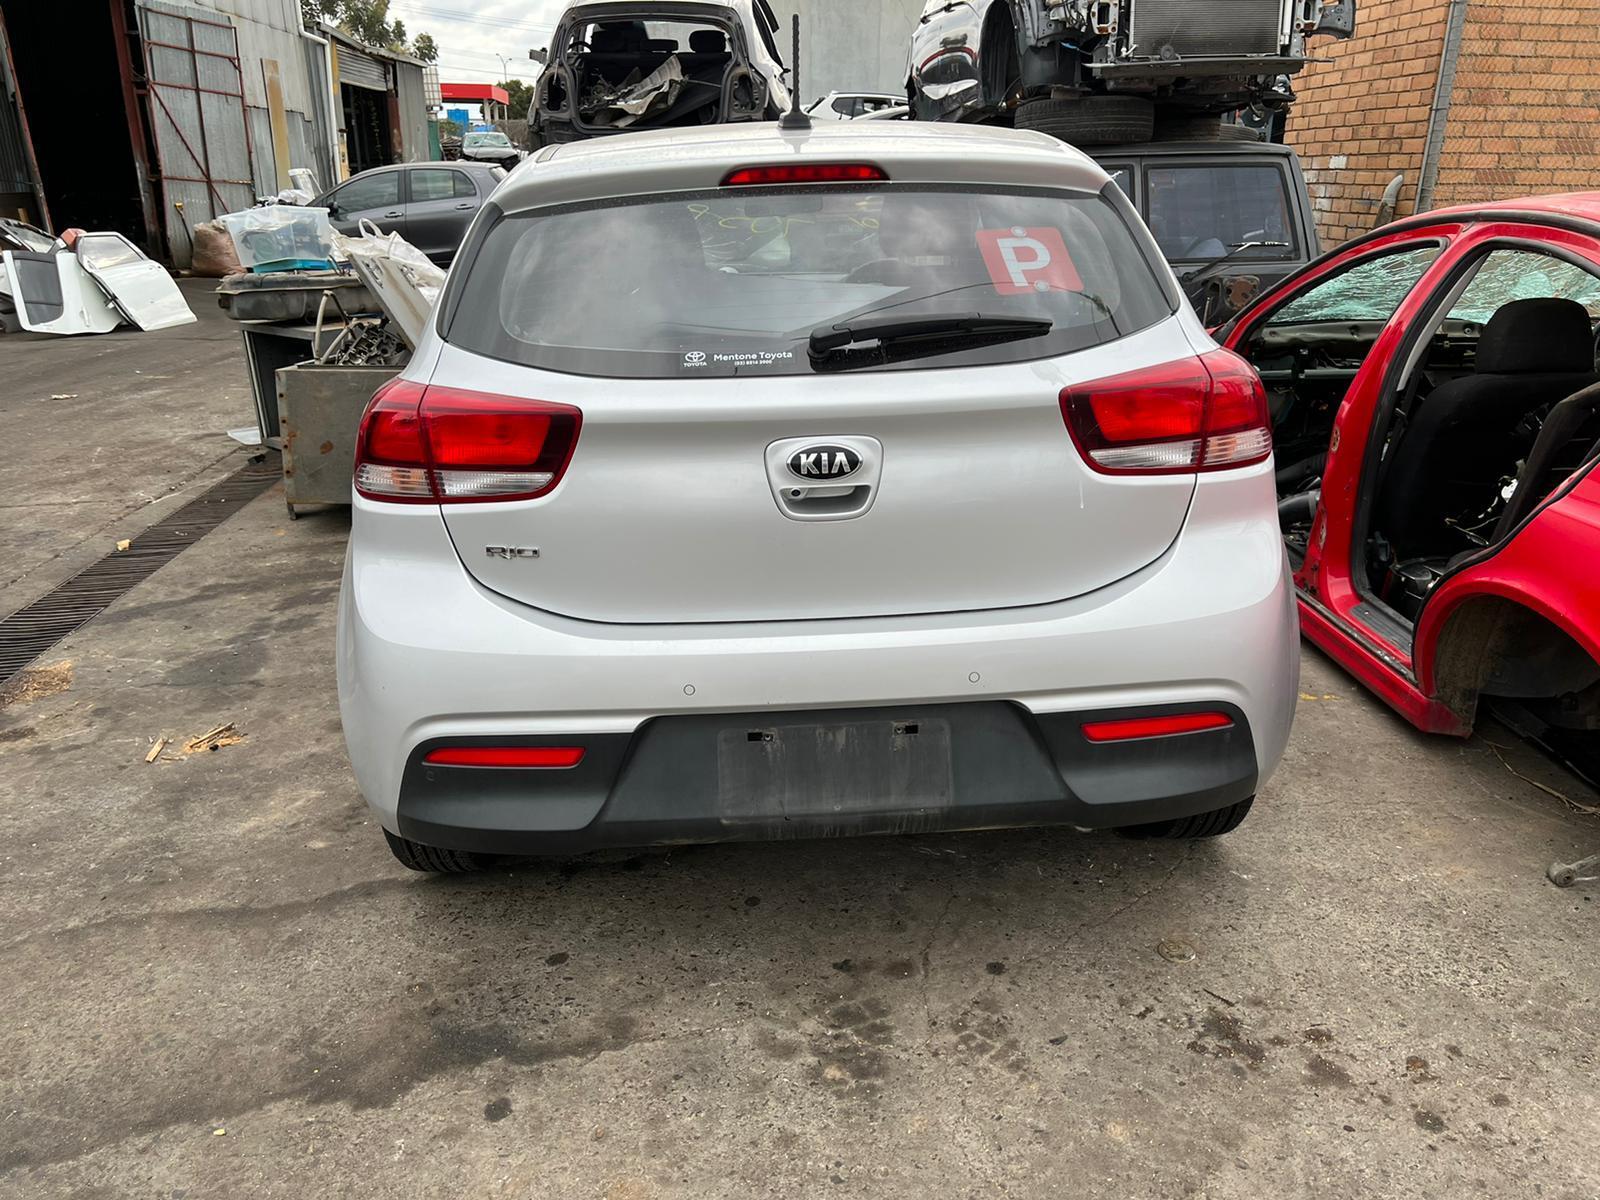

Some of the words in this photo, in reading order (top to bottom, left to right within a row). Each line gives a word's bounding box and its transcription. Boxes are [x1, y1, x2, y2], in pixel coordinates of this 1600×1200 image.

[996, 237, 1051, 287] P
[713, 353, 758, 362] Mentone
[759, 351, 793, 361] Toyota
[799, 452, 851, 475] KIA
[485, 545, 540, 560] RIO
